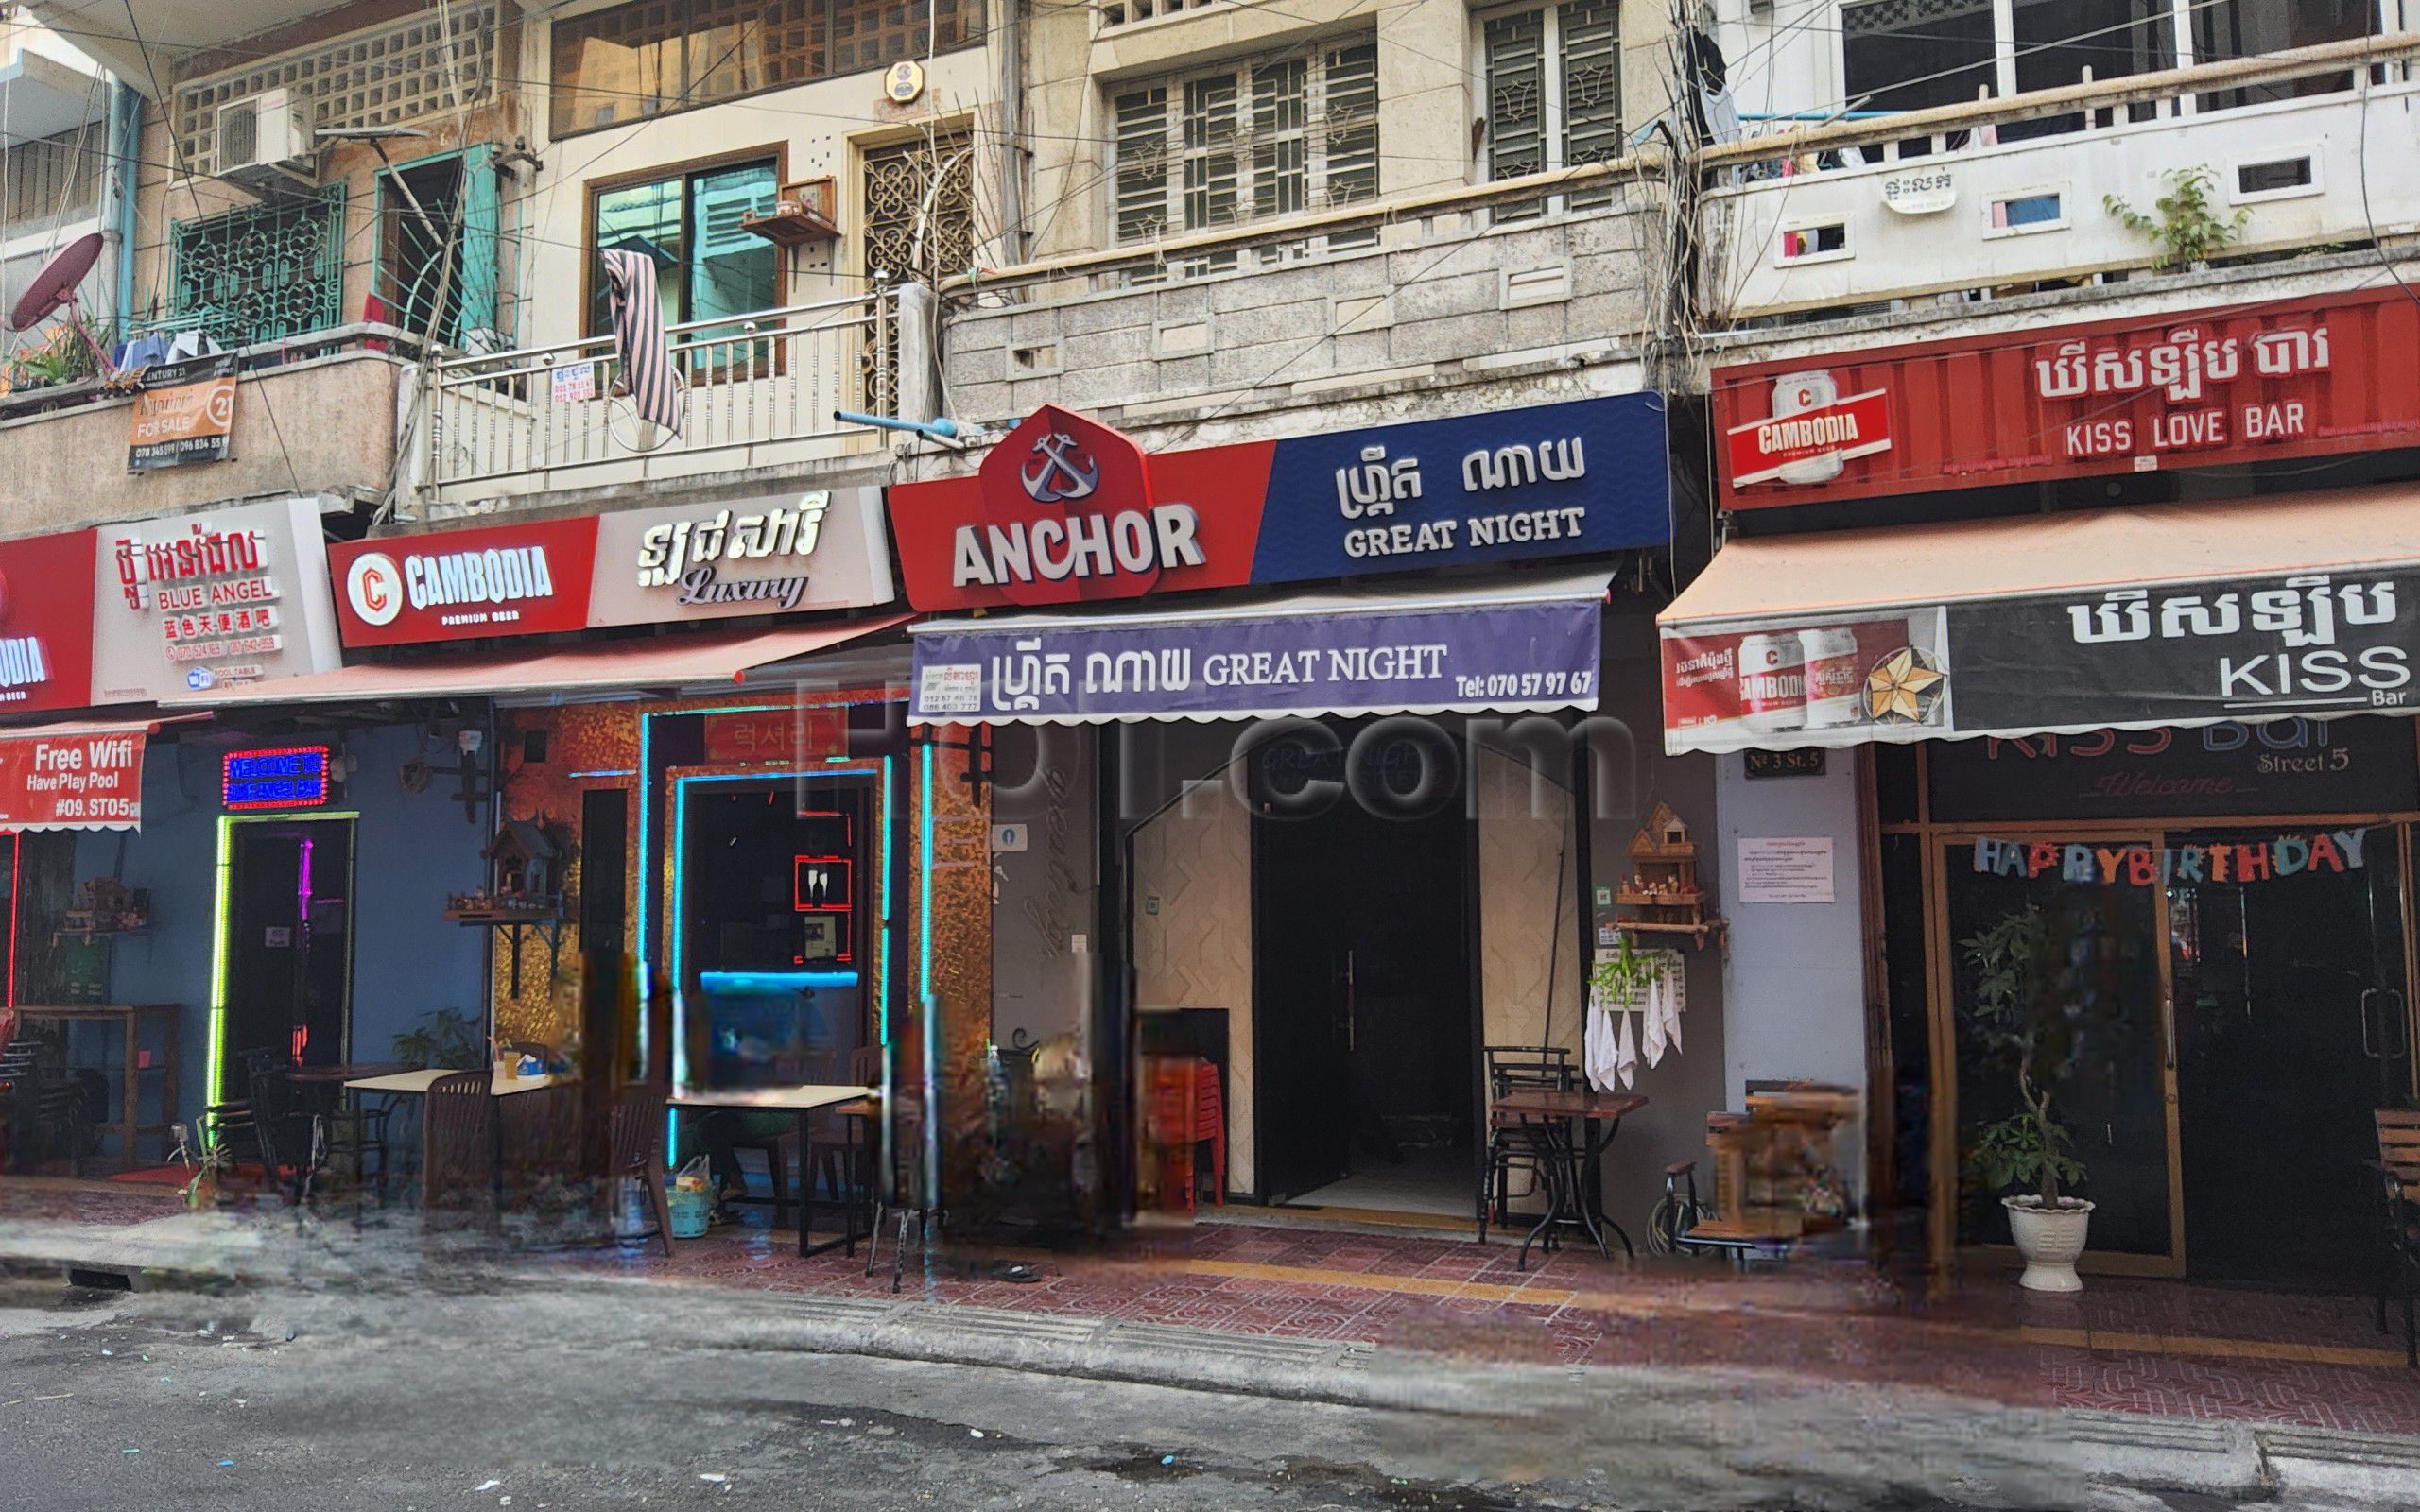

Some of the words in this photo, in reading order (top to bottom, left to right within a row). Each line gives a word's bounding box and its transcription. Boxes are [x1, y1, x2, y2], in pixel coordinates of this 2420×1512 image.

[144, 369, 178, 381] ENTURY
[137, 422, 160, 438] FOR
[161, 417, 190, 434] SALE
[1758, 413, 1859, 455] CAMBODIA
[2066, 421, 2132, 455] KISS
[2153, 411, 2225, 448] LOVE
[2245, 402, 2305, 438] BAR
[953, 504, 1207, 588] ANCHOR
[1343, 520, 1457, 558] GREAT
[1467, 507, 1585, 547] NIGHT
[405, 545, 554, 610] CAMBODIA
[677, 566, 809, 618] Luxury
[158, 587, 202, 610] BLUE
[211, 578, 272, 605] ANGEL
[441, 613, 488, 626] PREMIUM
[492, 610, 520, 622] BEER
[1203, 650, 1320, 686] GREAT
[1328, 644, 1447, 680] NIGHT
[2220, 646, 2411, 697] KISS
[1455, 675, 1484, 697] Tel:
[1487, 674, 1518, 696] 070
[1521, 673, 1543, 696] 57
[1545, 672, 1566, 695] 97
[1570, 671, 1592, 694] 67
[2371, 689, 2407, 707] Bar
[735, 719, 813, 752] 럭셔리
[35, 743, 82, 771] Free
[89, 740, 132, 768] Wifi
[2257, 755, 2324, 773] Street
[2329, 747, 2349, 771] 5
[27, 774, 56, 791] Have
[59, 772, 86, 793] Play
[89, 771, 118, 788] Pool
[2093, 772, 2235, 797] Welcome
[56, 799, 86, 816] #09.
[89, 799, 129, 816] ST05
